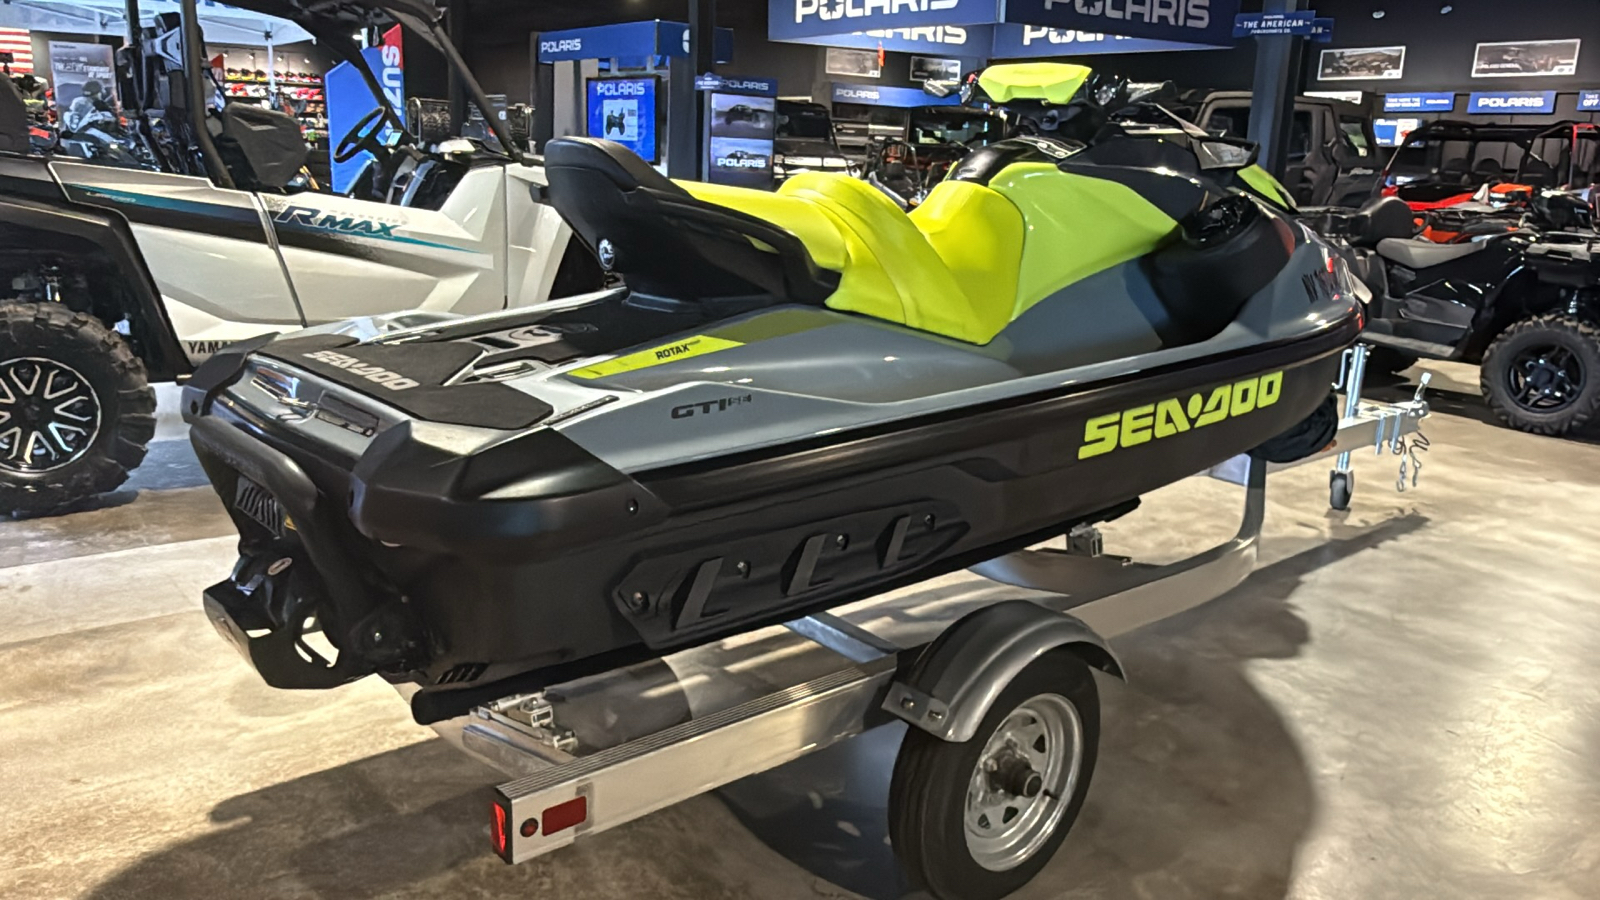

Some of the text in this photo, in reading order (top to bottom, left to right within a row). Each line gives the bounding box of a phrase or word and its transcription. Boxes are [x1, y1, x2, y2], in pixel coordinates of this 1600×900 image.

[795, 0, 960, 23] POLA
[1044, 0, 1210, 29] OLARIS
[1243, 19, 1304, 29] THE AMERICAN
[541, 38, 582, 53] POLARIS
[597, 82, 646, 96] POLARIS
[721, 80, 769, 91] POLARIS
[836, 88, 880, 99] POLARIS
[1478, 97, 1544, 107] POLARIS
[717, 157, 767, 168] POLARIS
[655, 344, 690, 360] ROTAX
[671, 398, 727, 419] GTI
